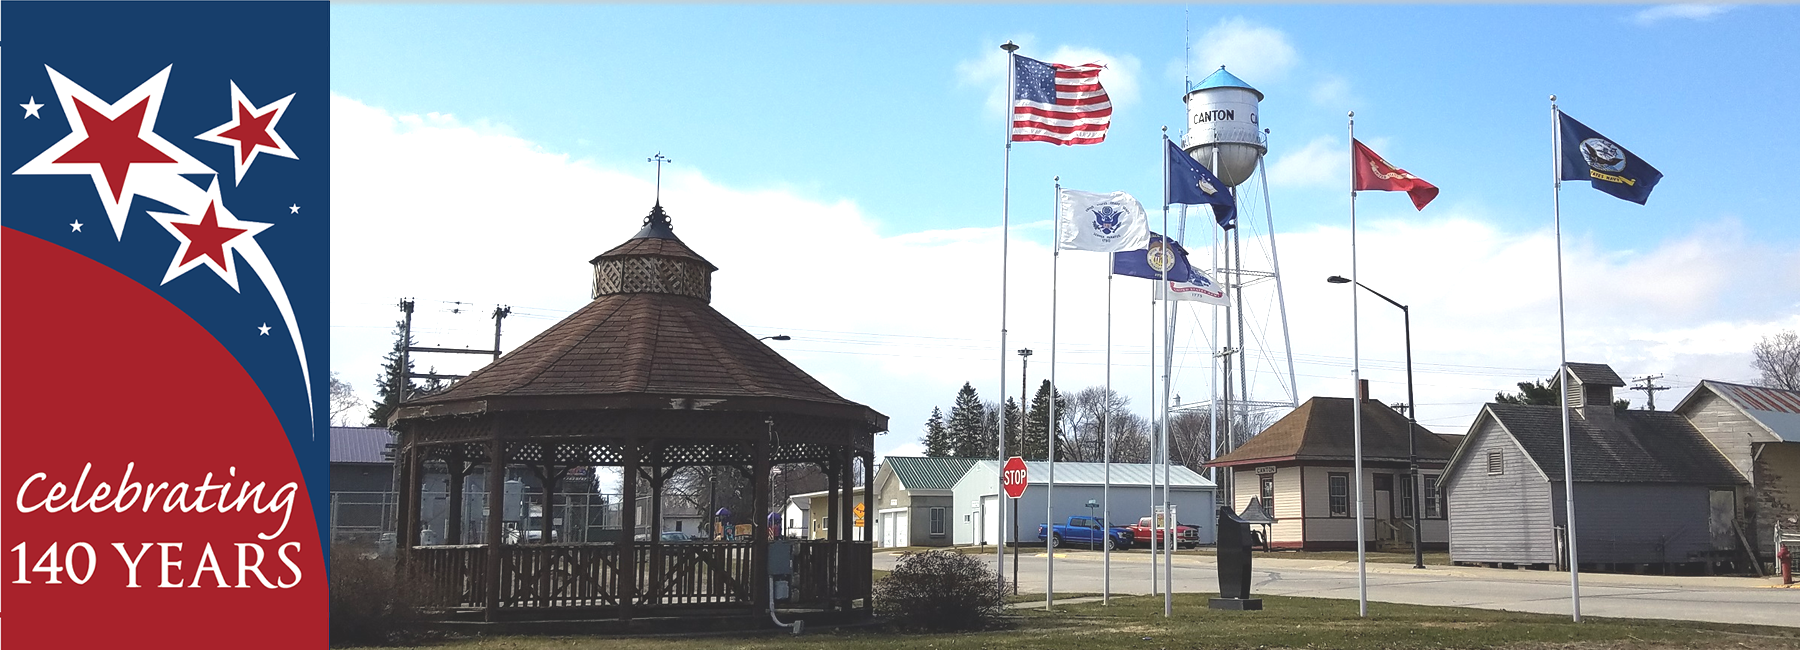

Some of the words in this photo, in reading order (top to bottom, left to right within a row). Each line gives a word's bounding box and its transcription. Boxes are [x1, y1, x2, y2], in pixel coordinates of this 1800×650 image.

[1193, 109, 1235, 125] CANTON
[1004, 469, 1026, 485] STOP
[1256, 466, 1275, 474] CANTON
